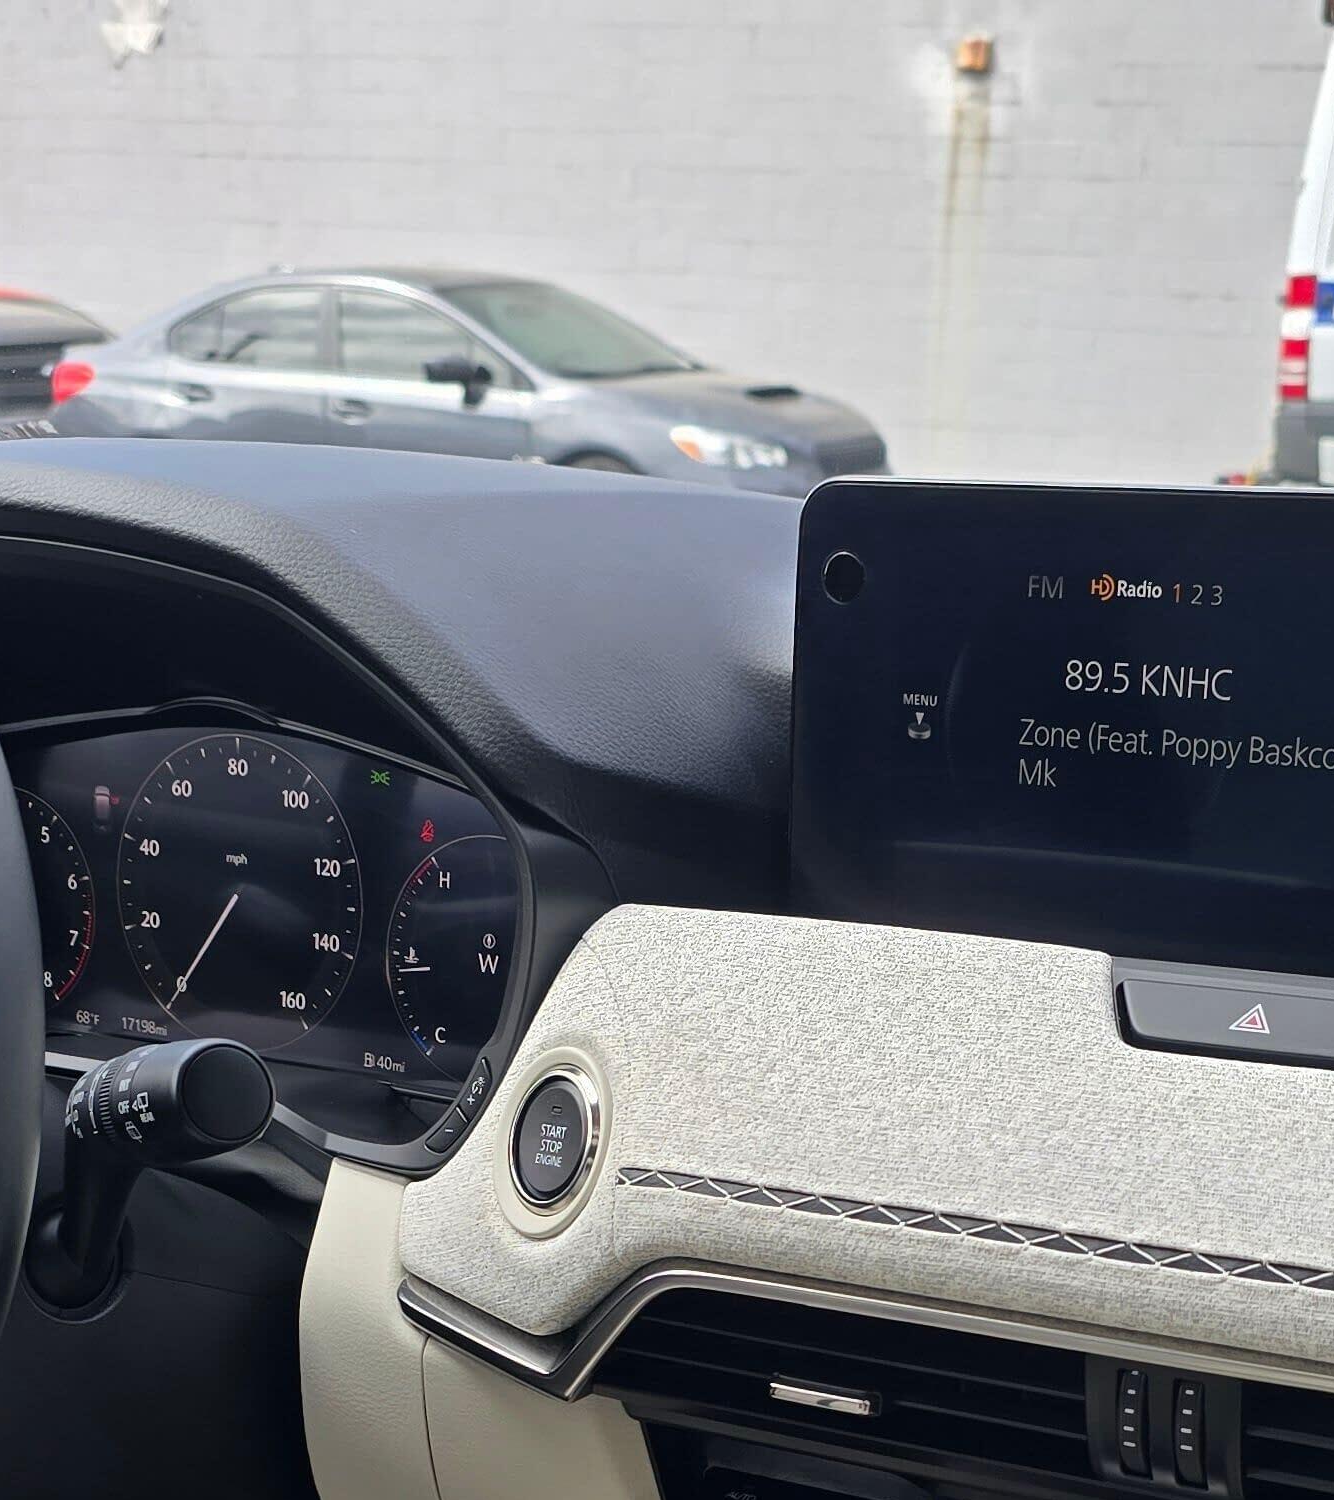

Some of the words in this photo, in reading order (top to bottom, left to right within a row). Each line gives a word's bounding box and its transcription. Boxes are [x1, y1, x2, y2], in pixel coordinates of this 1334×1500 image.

[1027, 575, 1064, 599] FM
[1116, 579, 1163, 599] Radio
[1191, 585, 1203, 605] 2
[1210, 585, 1224, 606] 3
[1065, 659, 1130, 694] 89.5
[1140, 664, 1233, 701] KNHC
[902, 693, 938, 707] MENU
[1018, 718, 1081, 749] Zone
[1088, 722, 1153, 755] (Feat.
[1161, 729, 1243, 769] Poppy
[227, 759, 249, 777] 80
[1018, 758, 1057, 788] Mk
[171, 780, 193, 798] 60
[281, 791, 309, 811] 100
[40, 827, 51, 845] 5
[139, 838, 161, 858] 40
[225, 852, 249, 867] mph
[314, 858, 341, 878] 120
[67, 873, 79, 891] 6
[439, 871, 452, 889] H
[141, 911, 161, 930] 20
[69, 930, 79, 947] 7
[312, 932, 341, 953] 140
[477, 952, 500, 975] W
[43, 971, 53, 989] 8
[279, 991, 307, 1011] 160
[435, 1026, 447, 1044] C
[541, 1123, 567, 1139] START
[540, 1139, 563, 1153] STOP
[534, 1153, 562, 1168] ENGINE
